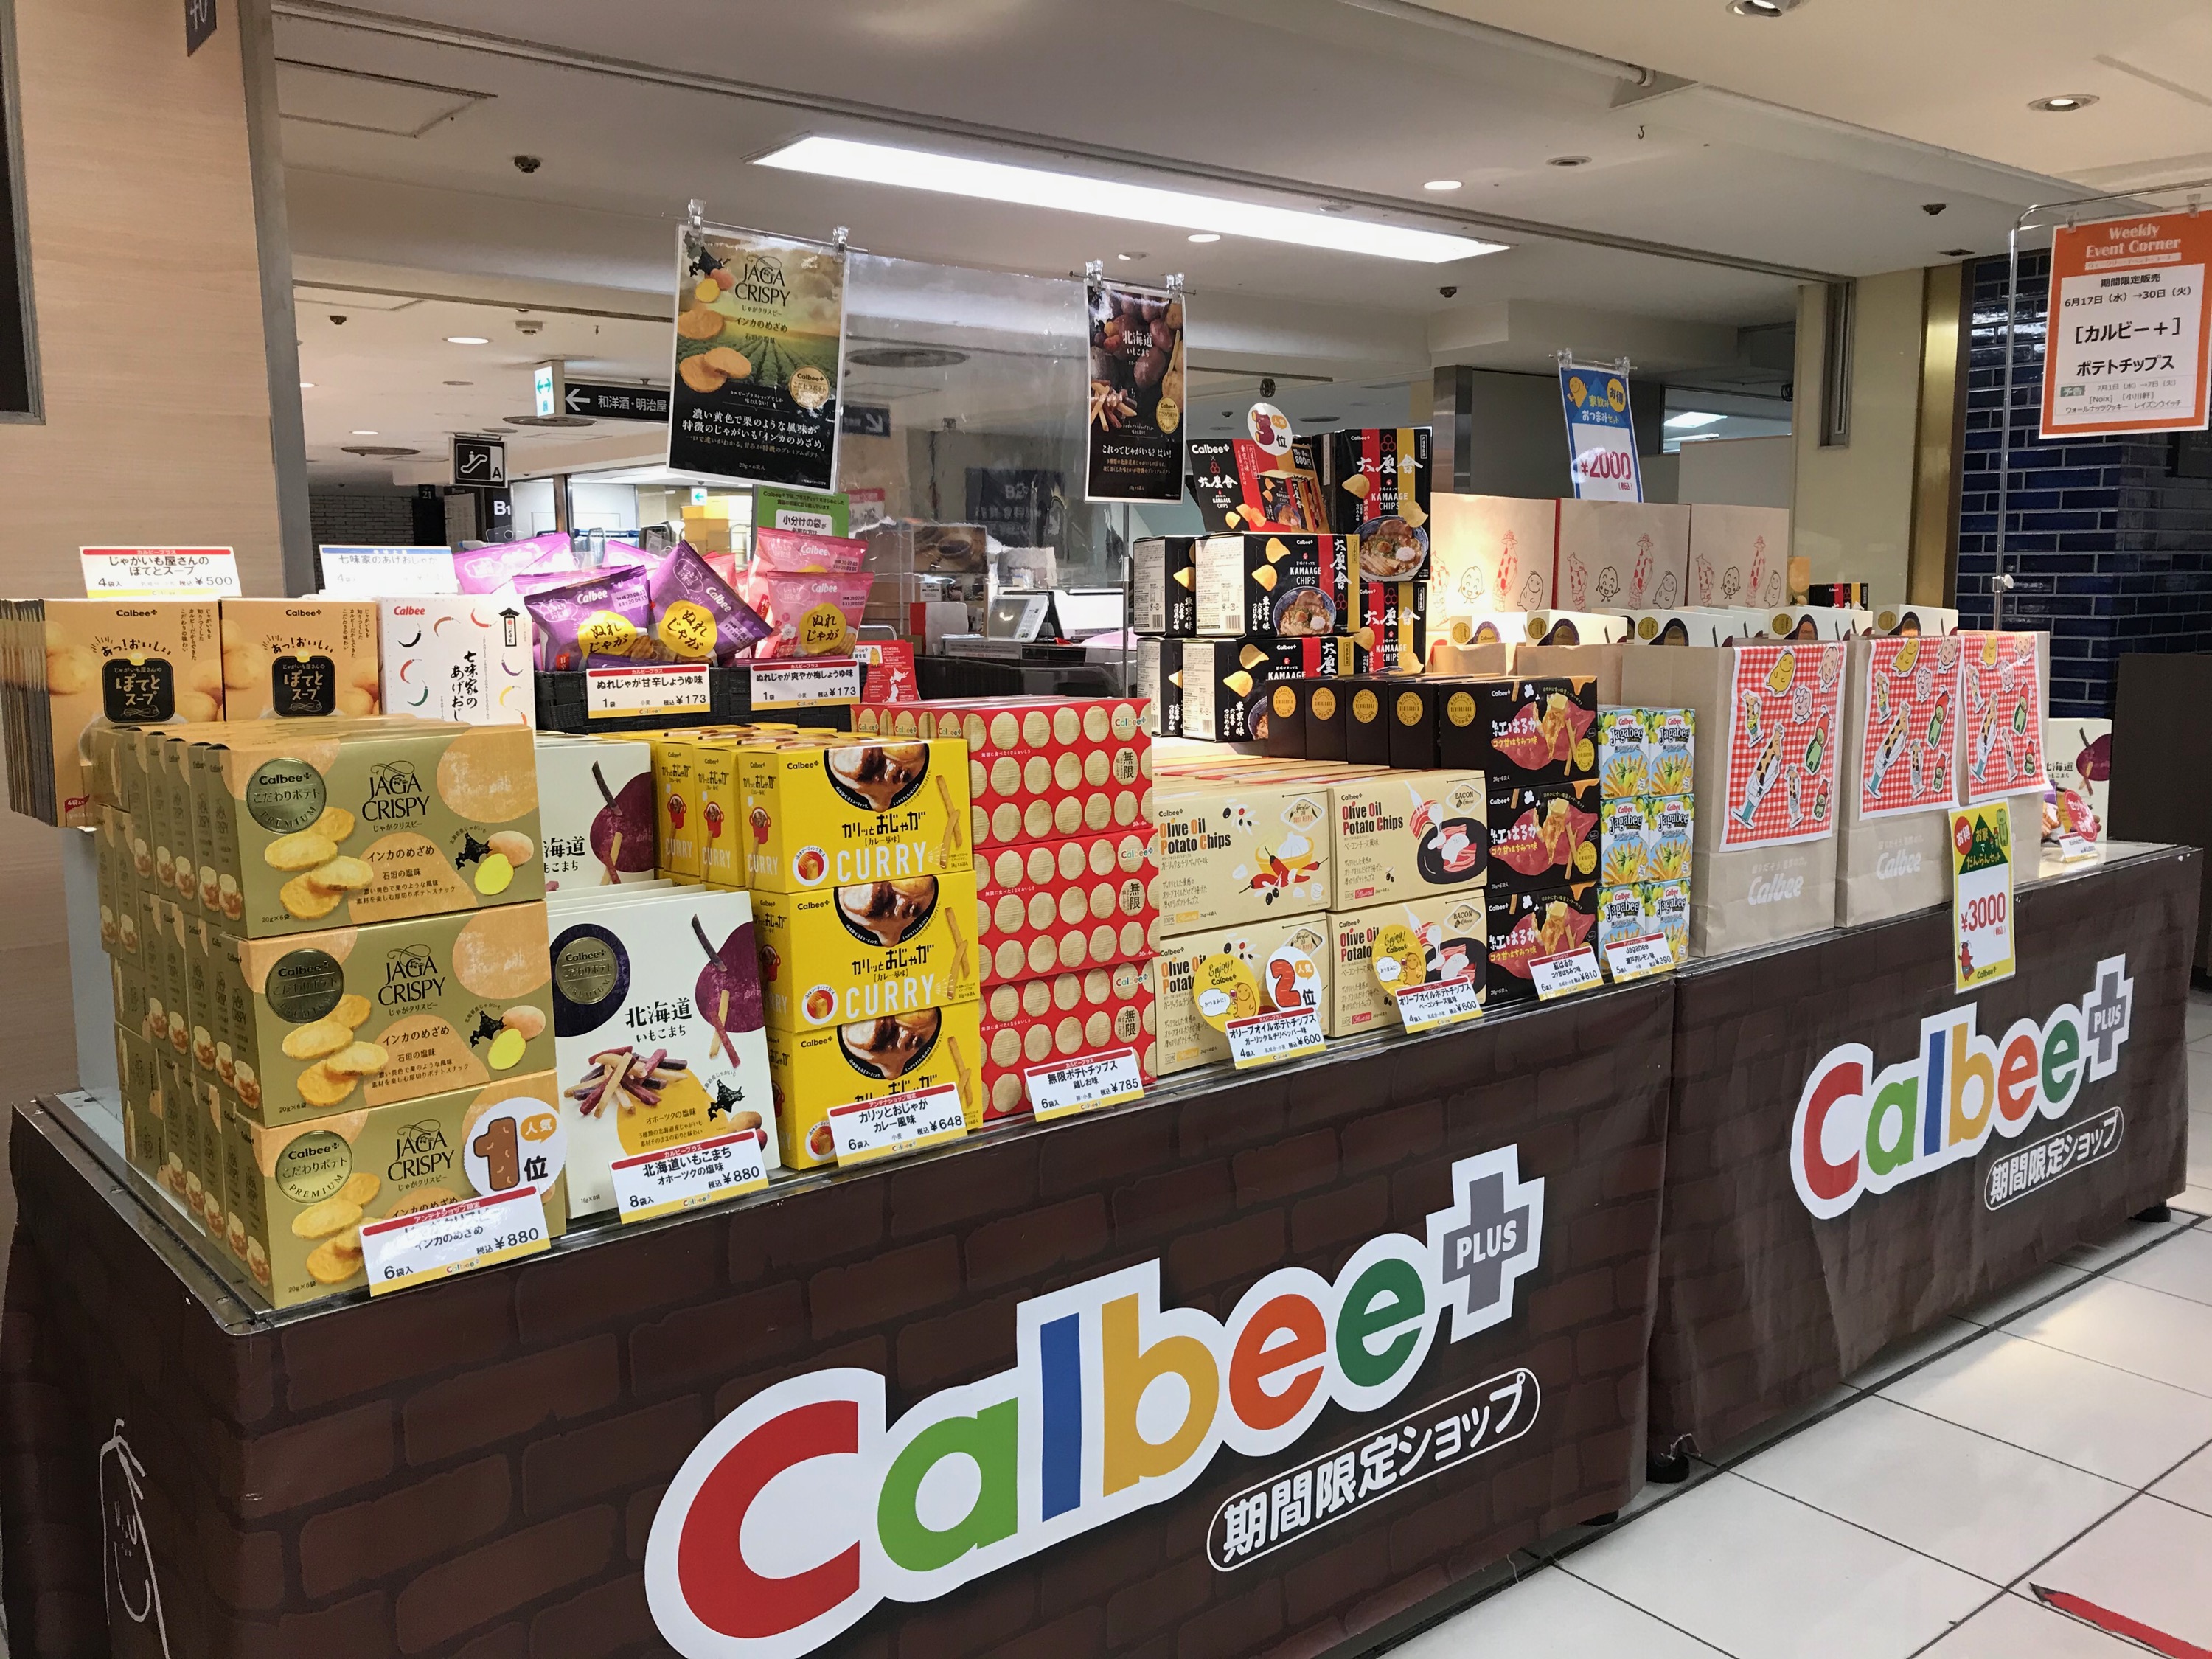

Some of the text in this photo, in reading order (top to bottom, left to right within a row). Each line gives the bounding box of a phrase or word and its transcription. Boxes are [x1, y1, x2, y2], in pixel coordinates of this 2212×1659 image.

[2109, 224, 2160, 240] Weekly
[2086, 238, 2181, 257] Event Corner
[743, 263, 785, 287] JAGA
[2101, 274, 2160, 288] 期間限定販売
[734, 282, 790, 307] CRISPY
[734, 316, 787, 333] インカのめざめ
[1123, 330, 1152, 348] 北海道
[2077, 355, 2174, 376] ポテトチップス
[2062, 386, 2084, 396] 予告
[692, 407, 819, 434] 濃い黄色で栗のような風味が
[1582, 410, 1619, 424] おつまみセット
[1276, 435, 1287, 448] 位
[492, 467, 501, 479] A
[1581, 451, 1631, 480] ¥2000
[1371, 493, 1408, 501] KAMAAGE
[1379, 501, 1400, 510] CHIPS
[494, 501, 510, 515] B1
[800, 543, 828, 556] Calbee
[109, 556, 209, 566] じゃがいも屋さんの
[130, 566, 193, 575] ぽてとスープ
[195, 576, 232, 585] ¥500
[812, 583, 838, 593] Calbee
[577, 590, 608, 604] Calbee
[706, 586, 731, 613] Calbee
[394, 606, 425, 616] Calbee
[591, 622, 621, 638] ぬれ
[589, 634, 628, 653] じゃが
[116, 674, 160, 692] ぽてと
[463, 650, 478, 709] 七味家の
[597, 675, 703, 689] ぬれじゃが甘辛しょうゆ味
[757, 670, 853, 681] ぬれじゃが爽やか梅しょうゆ味
[126, 691, 156, 706] スープ
[602, 699, 615, 708] 1袋
[676, 695, 706, 704] ¥173
[763, 687, 856, 700] 1袋 ¥173
[1492, 720, 1541, 736] 紅はるか
[1610, 725, 1644, 746] Jagabee
[1492, 737, 1538, 748] コク甘はちみつ味
[1123, 751, 1134, 779] 無限
[1455, 790, 1474, 799] BACON
[262, 807, 316, 827] PREMIUM
[362, 796, 430, 821] CRISPY
[1369, 801, 1381, 817] Oil
[1159, 818, 1206, 838] Olive Oil
[1343, 815, 1403, 835] Potato Chips
[666, 838, 692, 858] CURRY
[1161, 833, 1231, 855] Potato Chips
[367, 846, 434, 863] インカのめざめ
[1967, 852, 2000, 869] だんらんセット
[1877, 849, 1921, 879] Calbee
[1748, 873, 1804, 905] Calbee
[1453, 911, 1472, 919] BACON
[1961, 892, 2006, 932] ¥3000
[1626, 943, 1649, 954] Jagabee
[1553, 959, 1573, 970] 紅はるか
[1626, 953, 1655, 964] 瀬戸内レモン味
[1655, 955, 1672, 965] ¥390
[1551, 966, 1581, 978] コク甘はちみつ味
[1581, 970, 1598, 981] ¥810
[1270, 959, 1317, 1007] 2 位
[1399, 983, 1472, 1006] オリーブオイルポテトチップス
[1419, 998, 1458, 1009] ベーコンチーズ風味
[625, 997, 692, 1028] 北海道
[1456, 1001, 1477, 1012] ¥600
[1230, 1015, 1317, 1039] オリーブオイルポテトチップス
[2093, 1005, 2121, 1032] PLUS
[636, 1025, 686, 1043] いもこまち
[1240, 1034, 1321, 1057] 4袋入 ¥600
[1065, 1058, 1094, 1068] カルビープラス
[1048, 1061, 1118, 1085] 無限ポテトチップス
[1074, 1077, 1099, 1090] 鶏しお味
[1041, 1078, 1138, 1108] 6袋入 ¥785
[646, 1108, 696, 1125] オホーツクの塩味
[859, 1099, 928, 1124] カリッとおじゃが
[1804, 1020, 2079, 1200] Calbee
[525, 1119, 553, 1133] 人気
[639, 1120, 703, 1139] 3種類の北海道産じゃがいも
[874, 1114, 916, 1133] カレー風味
[849, 1116, 962, 1150] 6袋入 ¥648
[664, 1145, 702, 1157] カルビープラス
[1990, 1109, 2119, 1204] 期間限定ショップ
[524, 1156, 548, 1181] 位
[643, 1147, 731, 1177] 北海道いもこまち
[658, 1163, 723, 1185] オホーツクの塩味
[630, 1166, 759, 1207] 8袋入 ¥880
[415, 1225, 483, 1251] インカのめざめ
[1456, 1224, 1517, 1270] PLUS
[384, 1228, 539, 1279] 6袋入 ¥880
[678, 1259, 1425, 1639] Calbee
[1222, 1381, 1525, 1563] 期間限定ショップ
